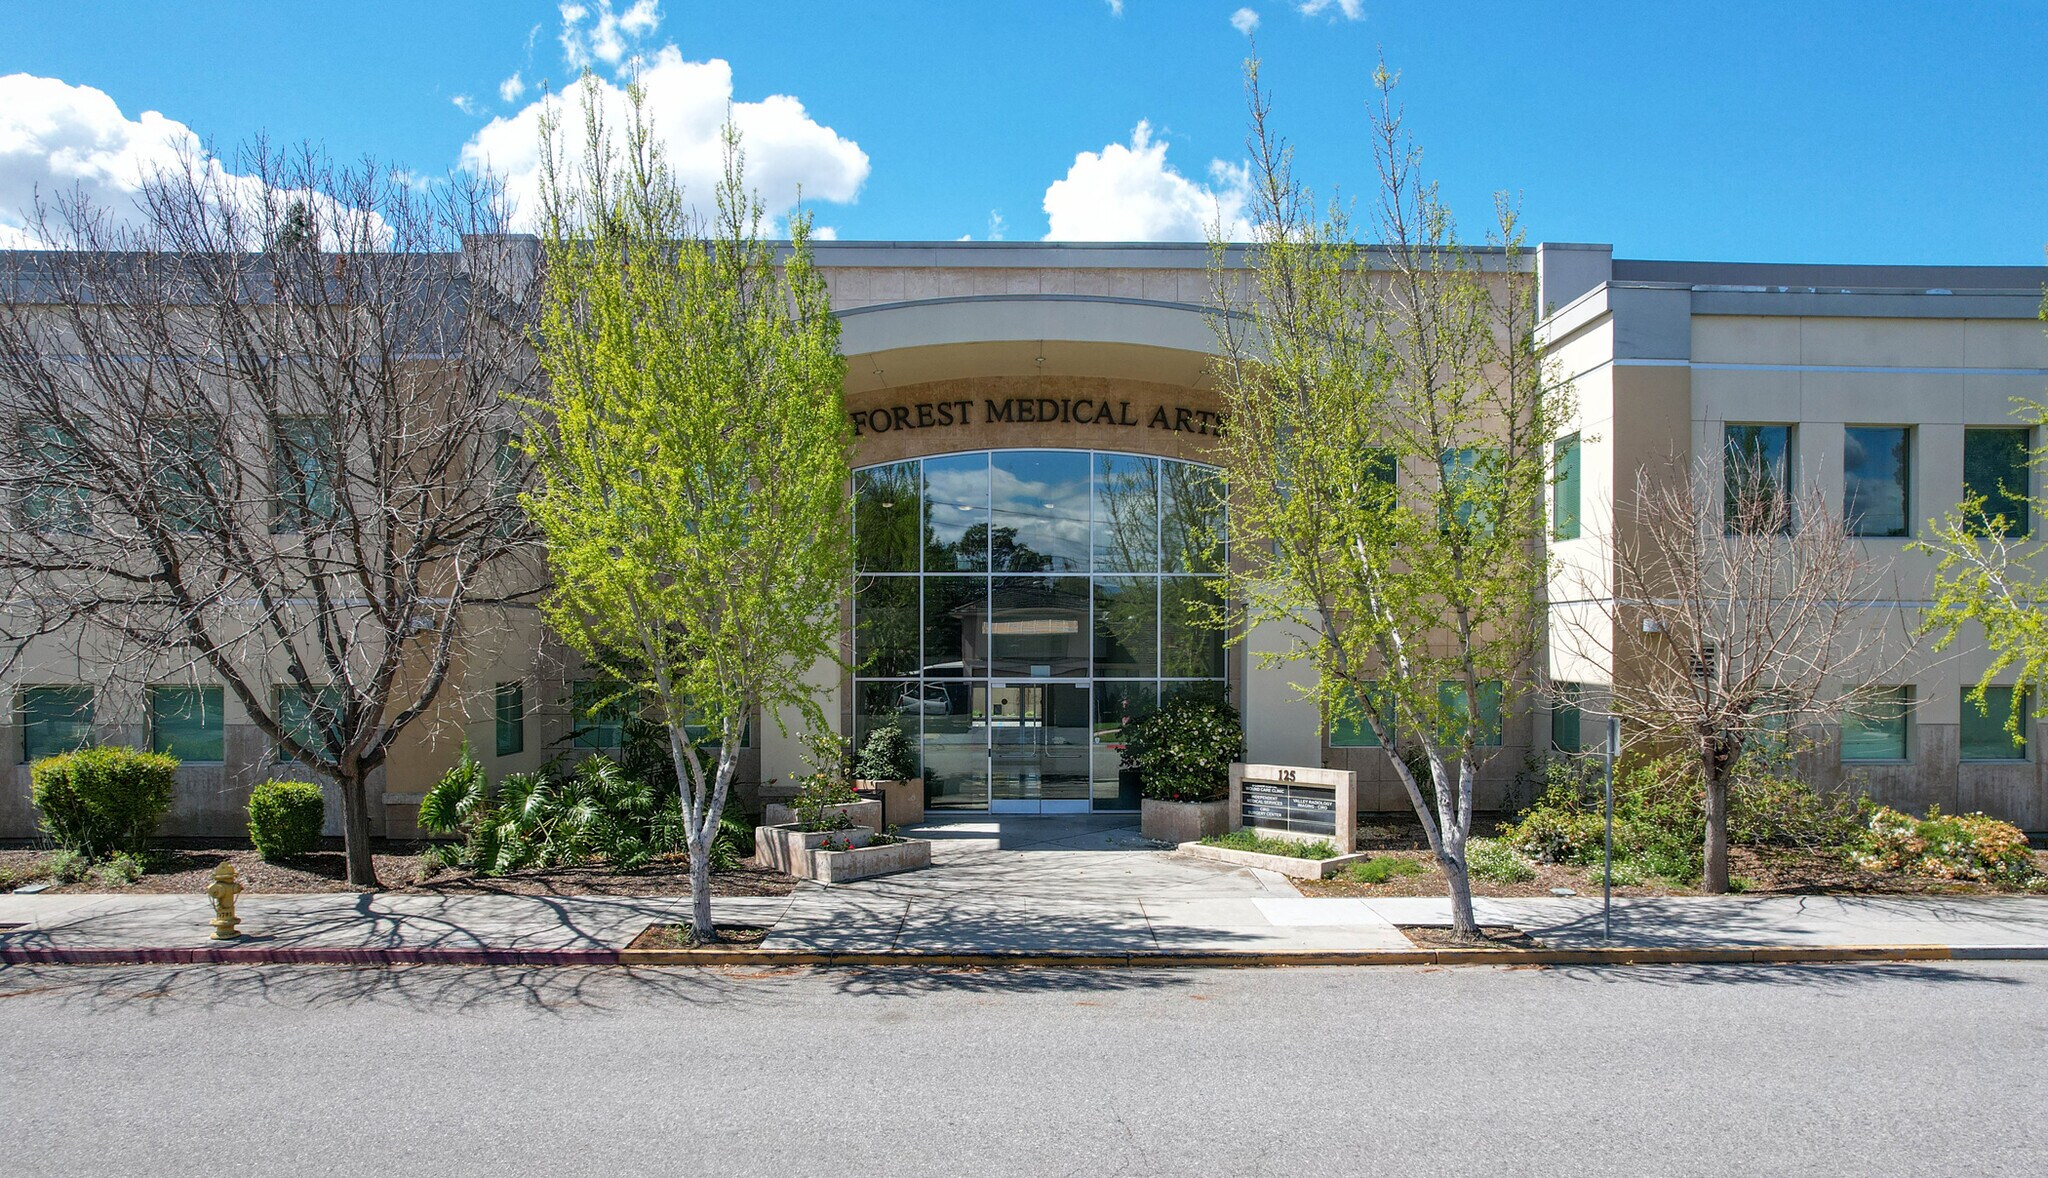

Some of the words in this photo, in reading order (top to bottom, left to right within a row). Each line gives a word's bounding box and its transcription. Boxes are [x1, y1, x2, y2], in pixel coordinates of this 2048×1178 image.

[850, 401, 973, 436] FOREST
[985, 398, 1139, 427] MEDICAL
[1148, 404, 1231, 438] ARTS
[1279, 769, 1296, 782] 125
